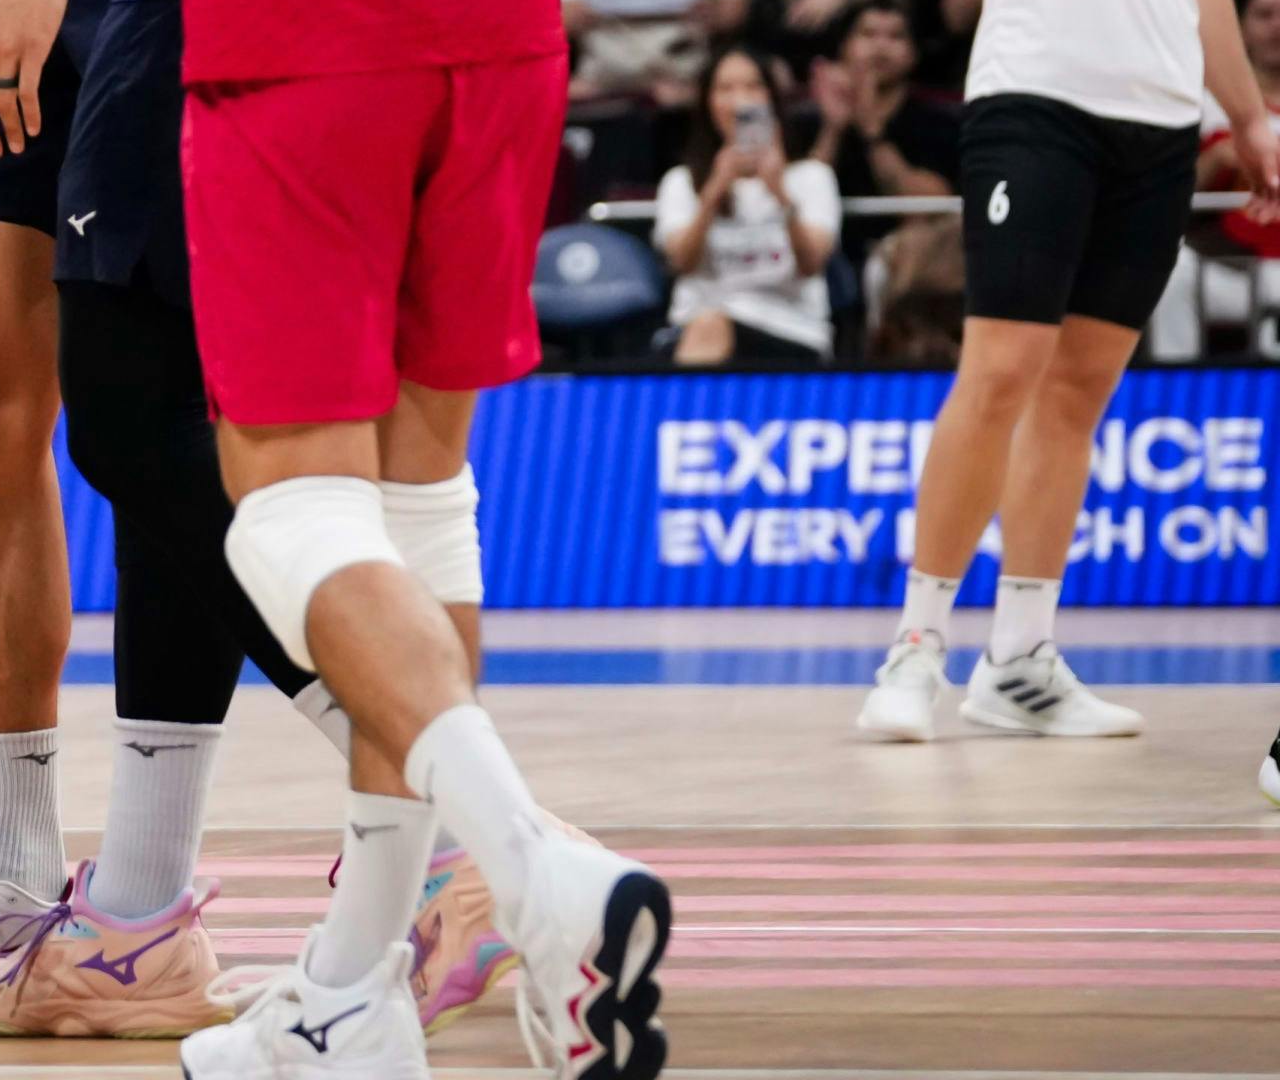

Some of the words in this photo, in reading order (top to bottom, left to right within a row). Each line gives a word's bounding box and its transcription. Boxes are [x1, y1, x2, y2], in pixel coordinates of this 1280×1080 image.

[987, 180, 1010, 225] 6
[659, 419, 1267, 495] EXPENCE
[659, 508, 884, 565] EVERY
[1158, 506, 1268, 561] ON
